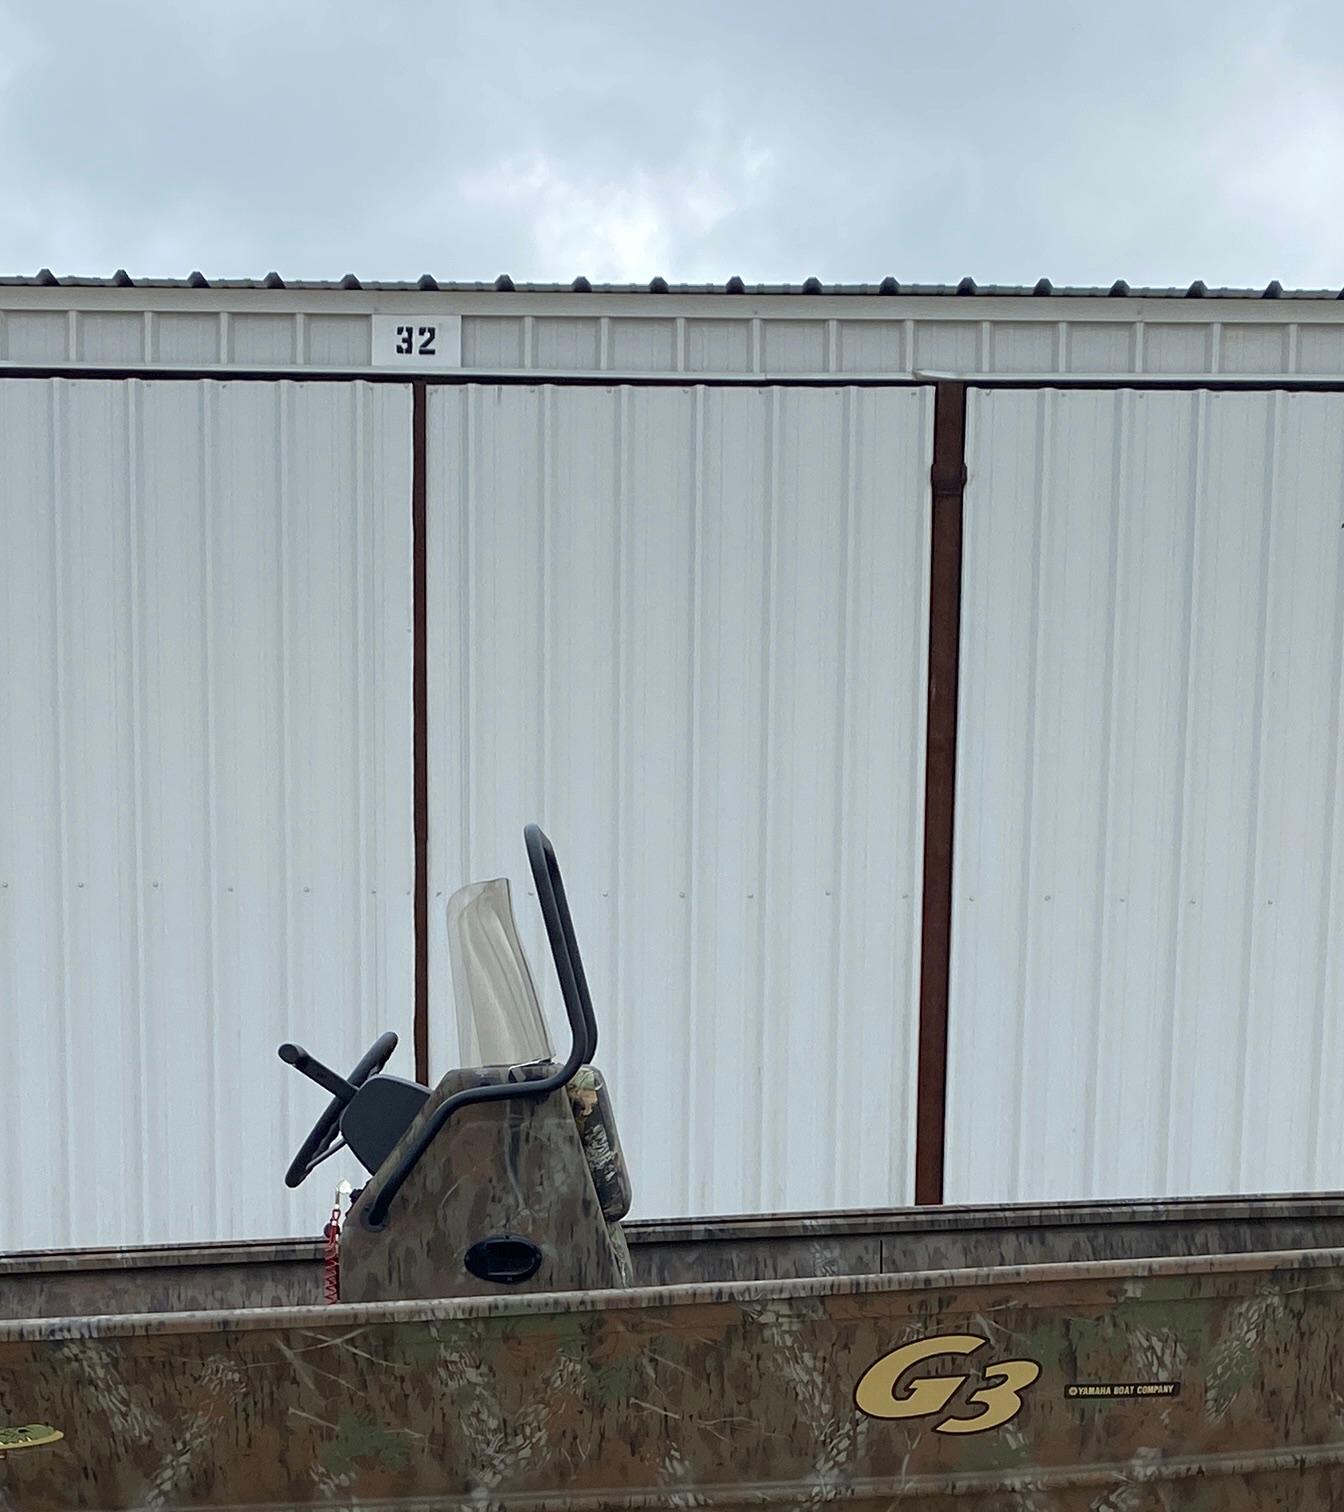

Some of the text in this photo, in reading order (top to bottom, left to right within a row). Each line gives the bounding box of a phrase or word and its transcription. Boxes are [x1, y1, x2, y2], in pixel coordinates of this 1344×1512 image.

[395, 326, 436, 355] 32
[855, 1333, 1042, 1436] G3
[1078, 1384, 1175, 1396] YAMAHA BOAT COMPANY
